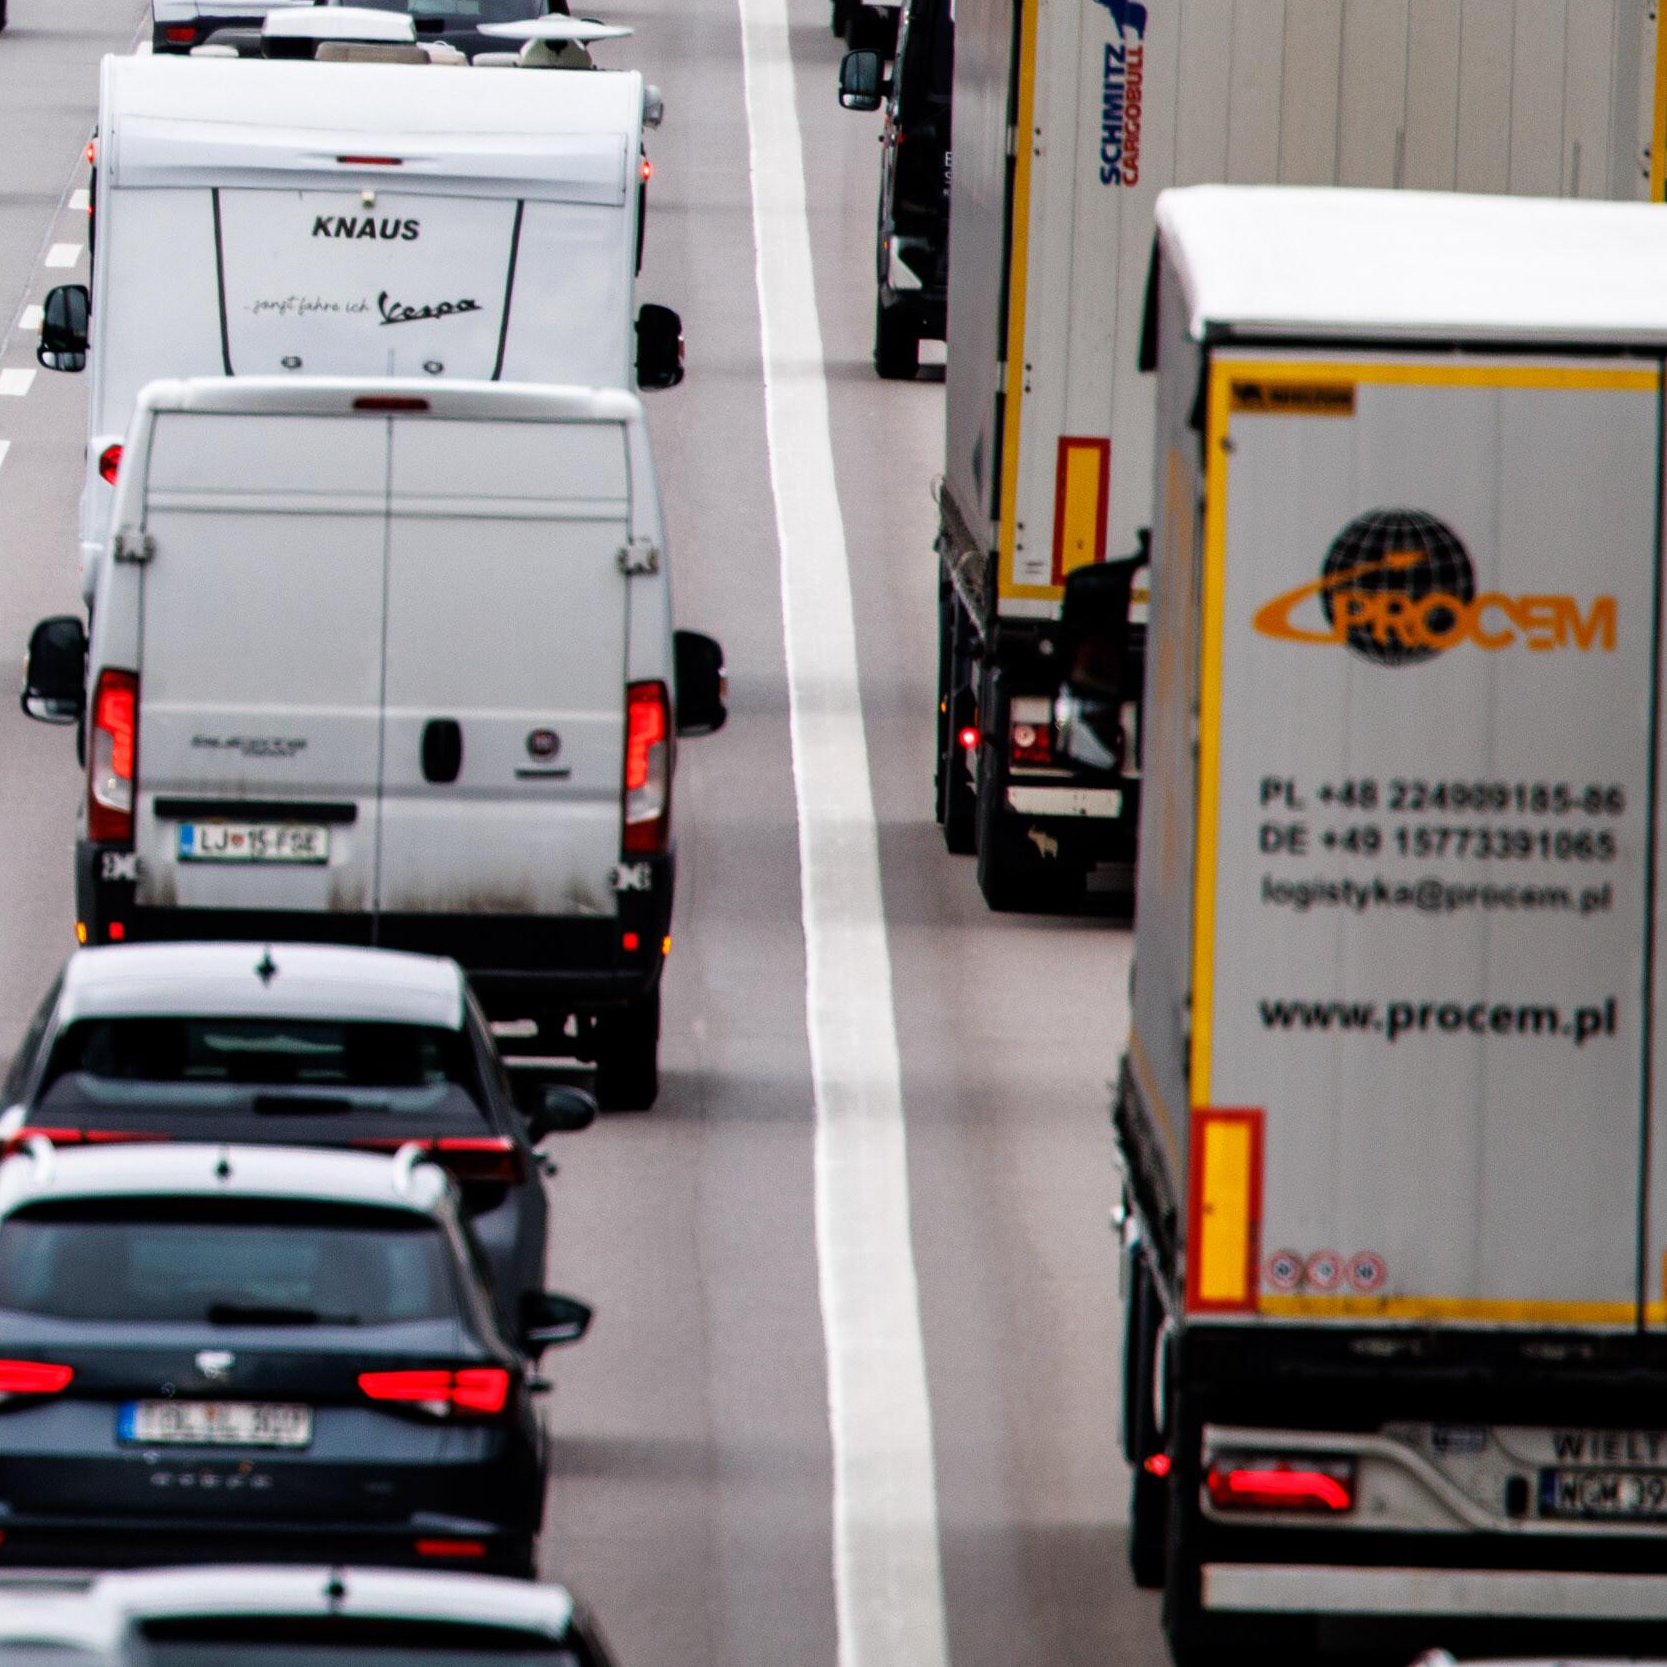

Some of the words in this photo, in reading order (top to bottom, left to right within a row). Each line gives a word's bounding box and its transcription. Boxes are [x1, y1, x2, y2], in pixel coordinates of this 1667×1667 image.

[1100, 42, 1126, 187] SCHMITZ
[1121, 44, 1144, 189] CARGOBULL
[311, 215, 420, 240] KNAUS
[377, 289, 484, 325] Vespa
[1332, 590, 1619, 653] PROCEM
[1259, 778, 1305, 810] PL
[1318, 779, 1379, 811] +48
[200, 828, 229, 850] LJ
[1259, 825, 1308, 855] DE
[1322, 828, 1383, 857] +49
[1396, 829, 1617, 861] 15773391065
[1261, 874, 1613, 916] logistyka@procem.pl
[1259, 994, 1618, 1046] www.procem.pl
